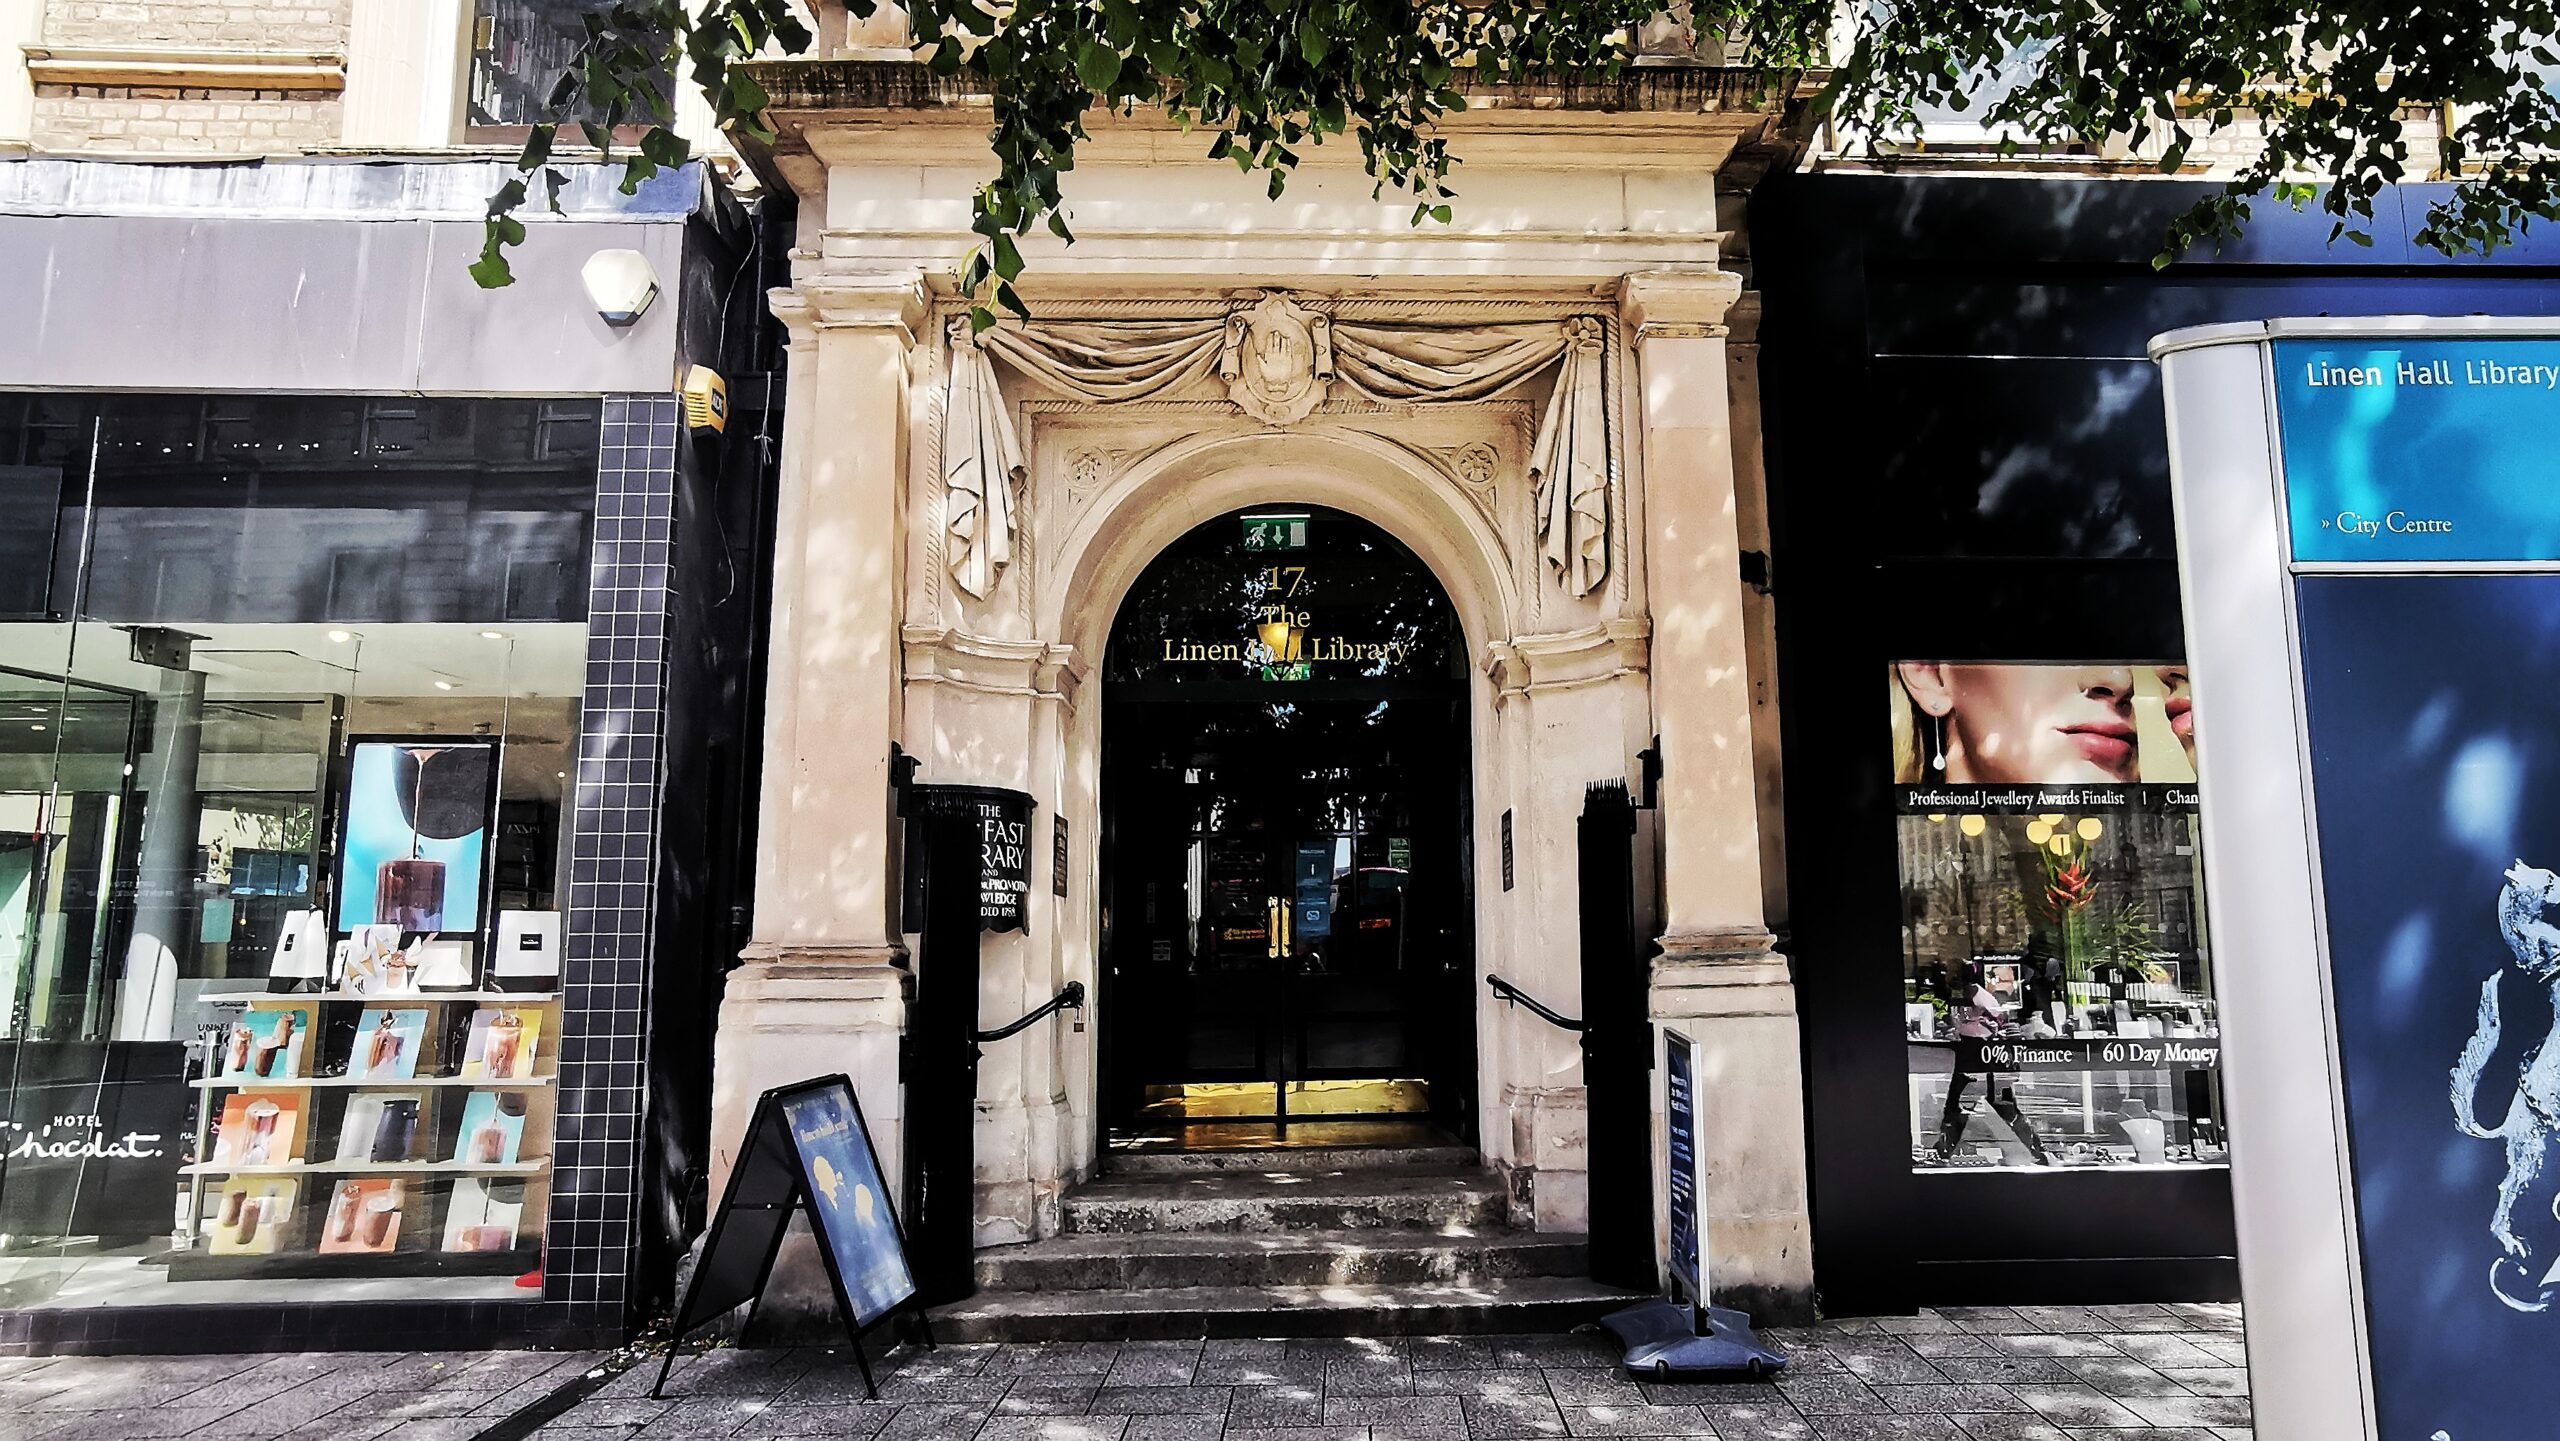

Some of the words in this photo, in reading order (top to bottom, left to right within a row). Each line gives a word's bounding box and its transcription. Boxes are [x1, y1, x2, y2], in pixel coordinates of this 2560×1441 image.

[2306, 361, 2383, 386] Linen
[2396, 360, 2453, 385] Hall
[2465, 359, 2559, 390] Library
[2336, 511, 2381, 538] City
[2386, 511, 2453, 533] Centre
[1266, 566, 1306, 598] 17
[1260, 604, 1311, 628] The
[1163, 637, 1242, 661] Linen
[1312, 636, 1410, 666] Library
[977, 804, 1001, 818] THE
[1909, 790, 1979, 806] Professional
[1981, 791, 2033, 810] Jewellery
[2036, 791, 2080, 806] Awards
[2082, 790, 2125, 805] Finalist
[982, 820, 1026, 845] FAST
[981, 843, 1026, 869] RARY
[1980, 1045, 2009, 1064] 0%
[2012, 1045, 2073, 1064] Finance
[2102, 1042, 2125, 1063] 60
[2129, 1043, 2162, 1067] Day
[2164, 1043, 2219, 1068] Money
[53, 1116, 103, 1127] HOTEL
